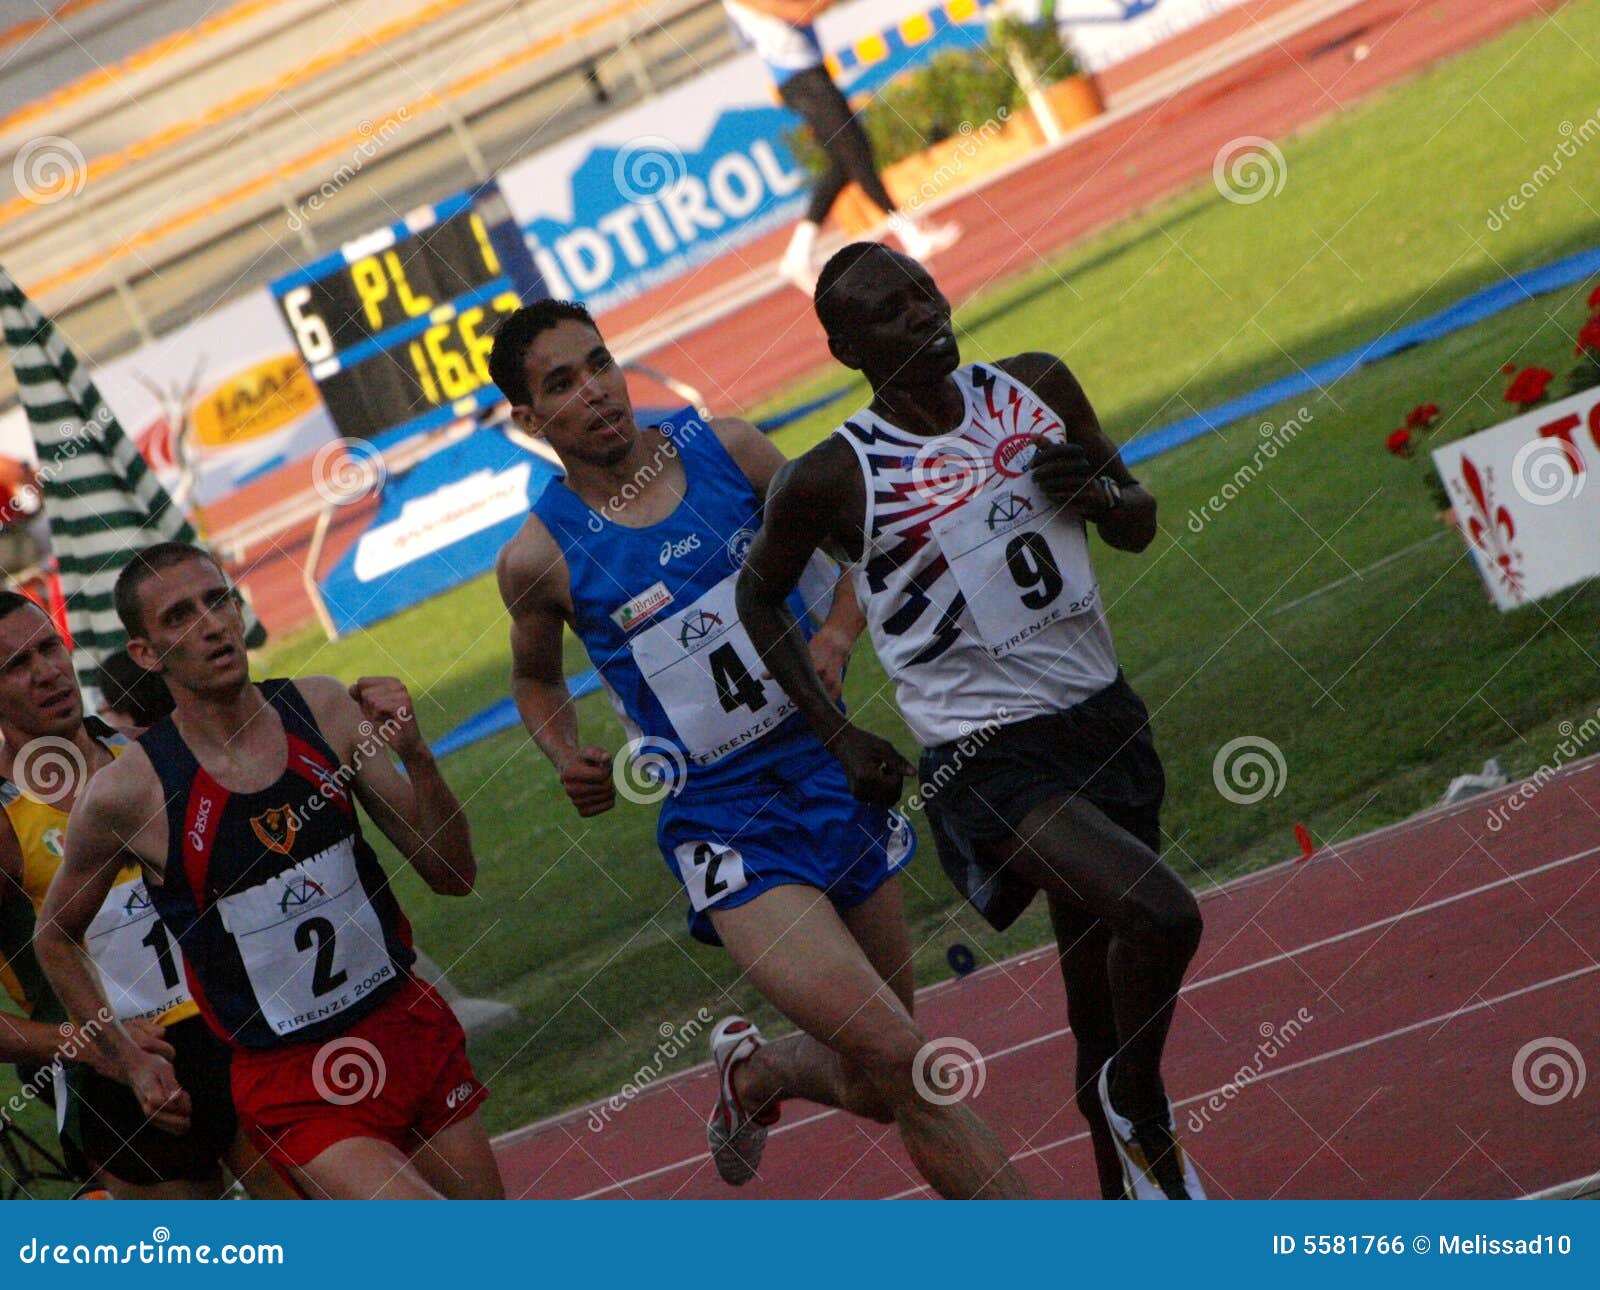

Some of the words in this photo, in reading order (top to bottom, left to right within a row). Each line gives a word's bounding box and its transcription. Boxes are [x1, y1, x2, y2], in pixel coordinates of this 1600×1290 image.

[284, 286, 334, 364] 6
[351, 250, 433, 330] PL
[1538, 402, 1600, 475] T
[1006, 532, 1063, 610] 9
[993, 609, 1062, 656] FIRENZE
[709, 641, 768, 714] 4
[701, 716, 774, 765] FIRENZE
[694, 843, 729, 899] 2
[142, 918, 180, 990] 1
[294, 917, 348, 998] 2
[277, 995, 352, 1031] FIRENZE
[354, 965, 391, 997] 2008
